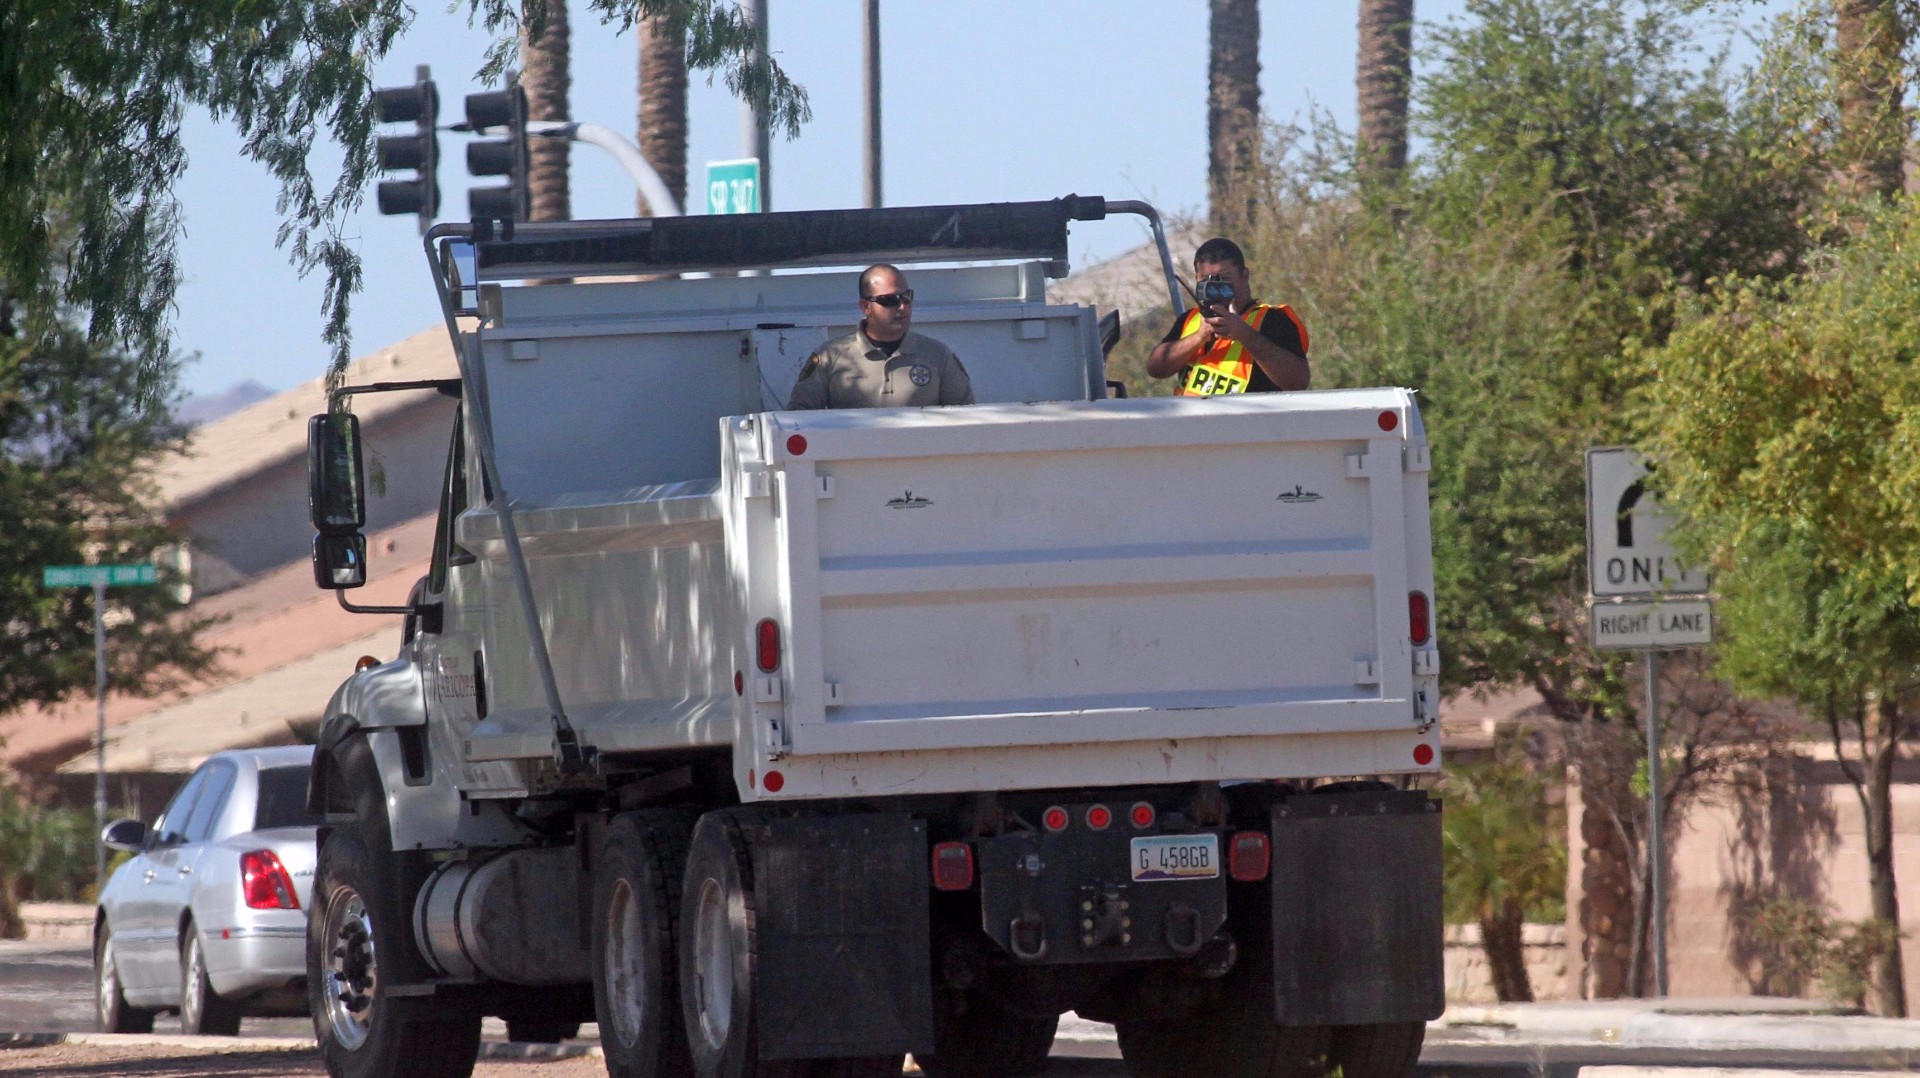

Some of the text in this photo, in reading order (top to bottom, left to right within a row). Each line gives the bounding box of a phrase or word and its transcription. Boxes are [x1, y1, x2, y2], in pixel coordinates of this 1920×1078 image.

[1601, 613, 1704, 634] RIGHT LANE
[1140, 846, 1209, 869] G 458GB
